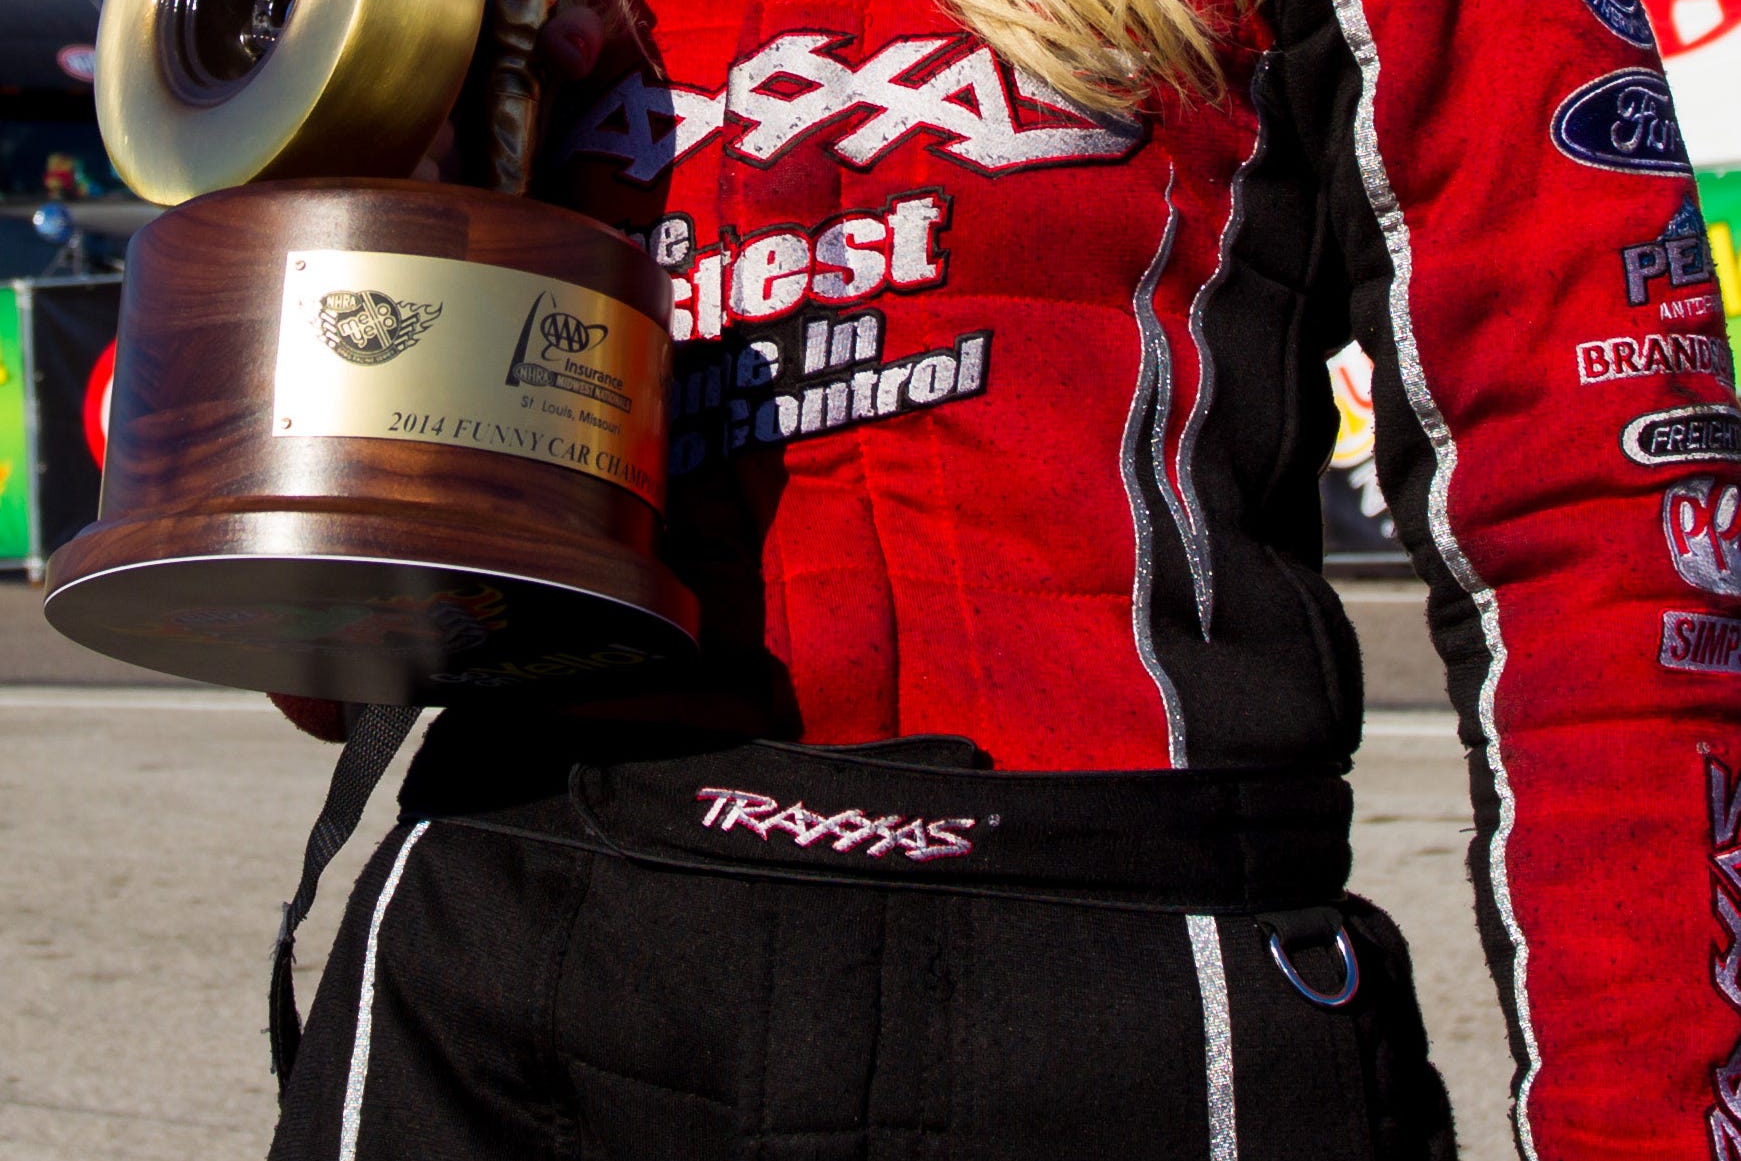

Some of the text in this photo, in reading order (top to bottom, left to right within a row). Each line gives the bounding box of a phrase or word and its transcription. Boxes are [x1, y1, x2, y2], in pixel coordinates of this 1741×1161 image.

[1622, 237, 1714, 306] PE
[325, 292, 357, 308] NHRA
[542, 313, 588, 354] AAA
[515, 366, 554, 385] NHRA
[564, 358, 625, 392] Insurance
[541, 399, 575, 422] Louis,
[578, 409, 622, 437] Missouri
[387, 411, 446, 435] 2014
[453, 418, 544, 452] FUNNY
[548, 437, 590, 467] CAR
[1669, 616, 1741, 667] SIMP
[696, 787, 976, 863] TRAXXAS
